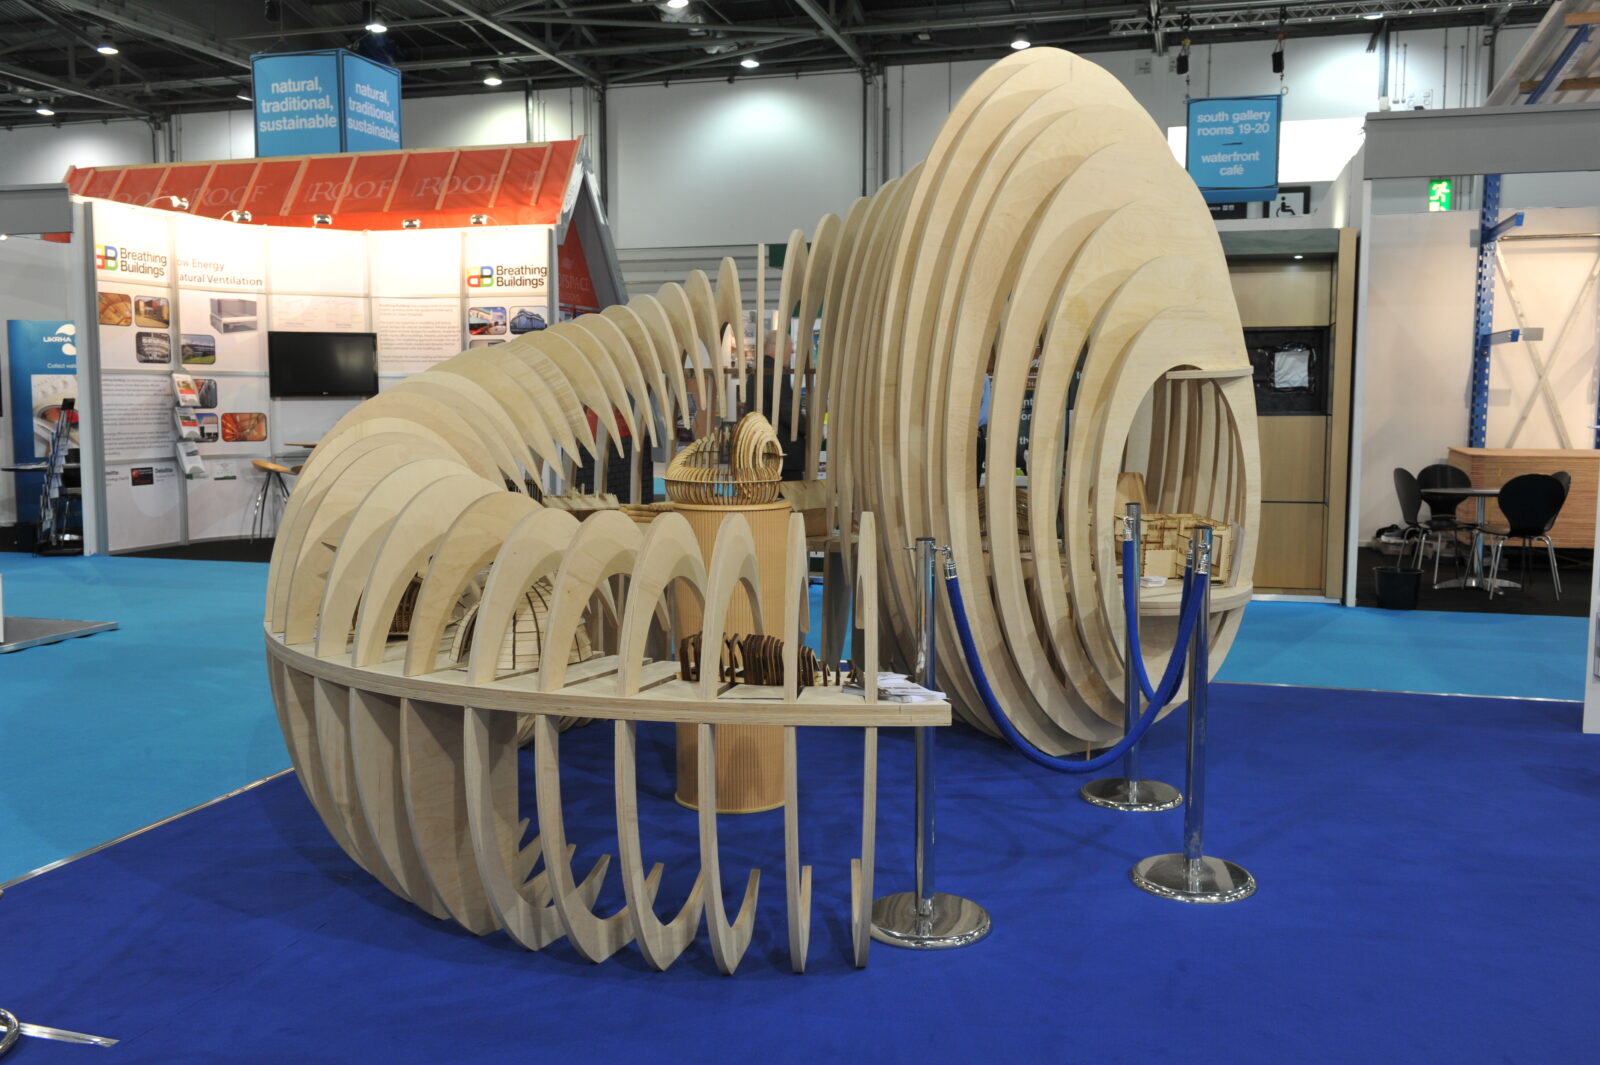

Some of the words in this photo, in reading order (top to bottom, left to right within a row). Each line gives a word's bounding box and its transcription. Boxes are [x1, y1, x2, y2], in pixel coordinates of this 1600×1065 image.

[271, 76, 322, 94] natural,
[355, 83, 389, 107] natural,
[261, 95, 334, 113] traditional,
[348, 97, 397, 126] traditional,
[259, 115, 337, 133] sustainable
[1197, 111, 1229, 123] south
[1232, 110, 1271, 123] gallery
[346, 117, 399, 143] sustainable
[1197, 126, 1234, 136] rooms
[1238, 123, 1270, 135] 19-20
[1200, 151, 1260, 163] waterfront
[1219, 164, 1244, 176] café
[120, 247, 167, 266] Breathing
[120, 260, 165, 279] Buildings
[192, 258, 225, 272] Energy
[496, 265, 548, 278] Breathing
[179, 274, 205, 283] atural
[207, 274, 263, 286] Ventilation
[496, 276, 545, 289] Buildings
